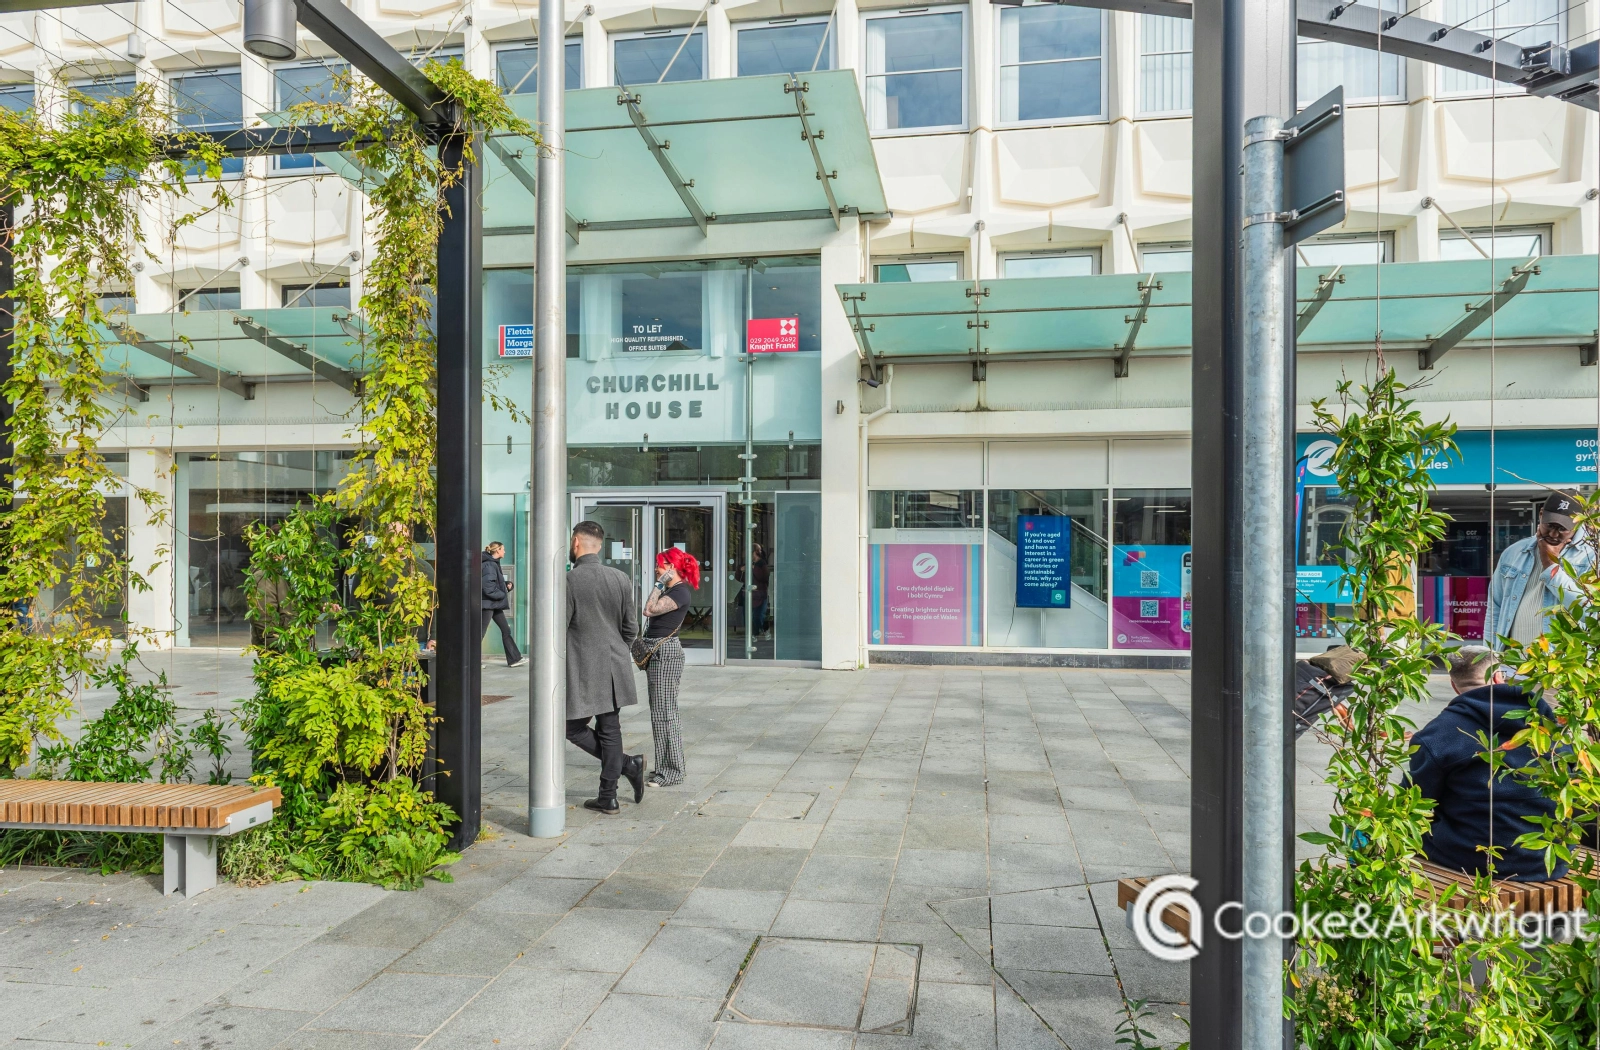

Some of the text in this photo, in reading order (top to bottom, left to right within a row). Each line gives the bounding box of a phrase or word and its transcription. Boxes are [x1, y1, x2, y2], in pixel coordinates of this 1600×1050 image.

[647, 325, 662, 333] LET
[750, 343, 774, 351] Knight
[586, 373, 719, 394] CHURCHILL
[605, 400, 702, 420] HOUSE
